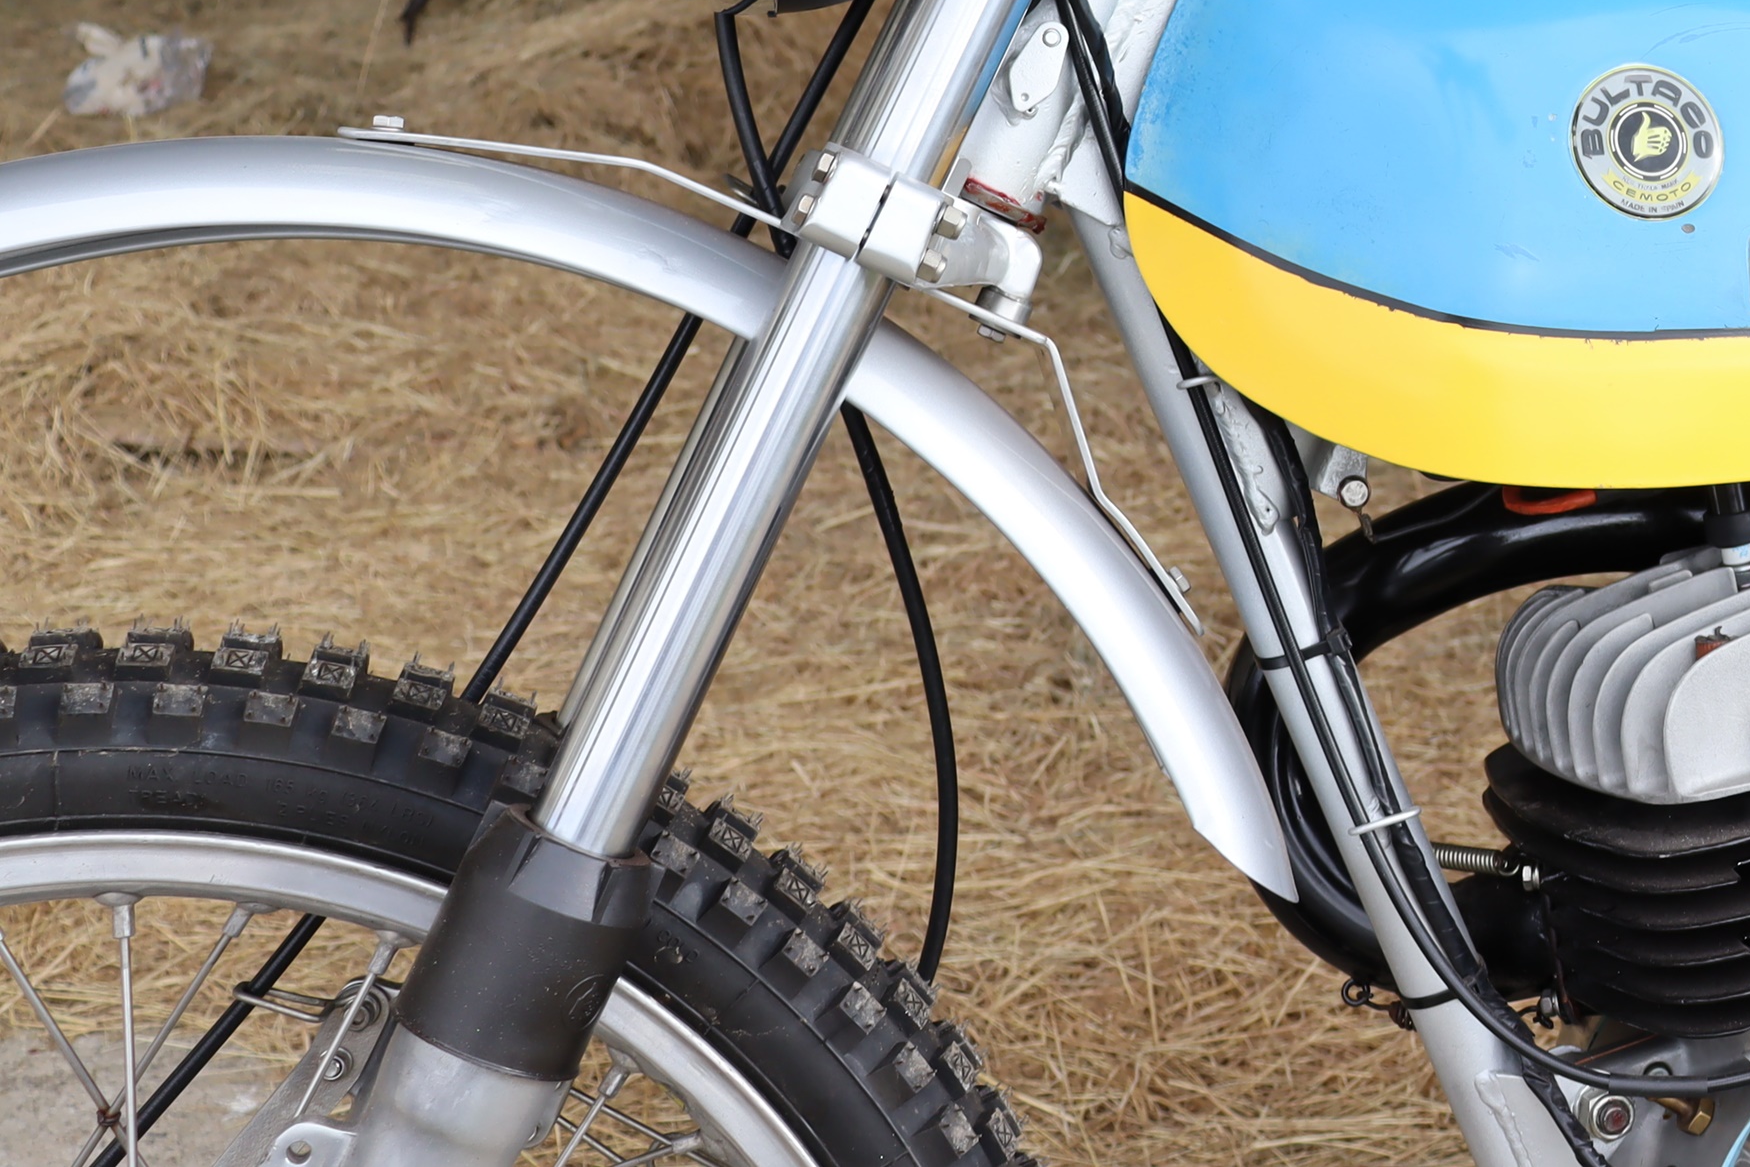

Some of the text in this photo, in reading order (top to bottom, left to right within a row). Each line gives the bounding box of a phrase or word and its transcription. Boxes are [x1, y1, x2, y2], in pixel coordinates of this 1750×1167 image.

[1581, 74, 1714, 159] BULTACO
[1612, 180, 1691, 201] CEMOTO
[1621, 198, 1645, 212] MADE
[126, 765, 177, 783] MAX
[191, 770, 249, 788] LOAD
